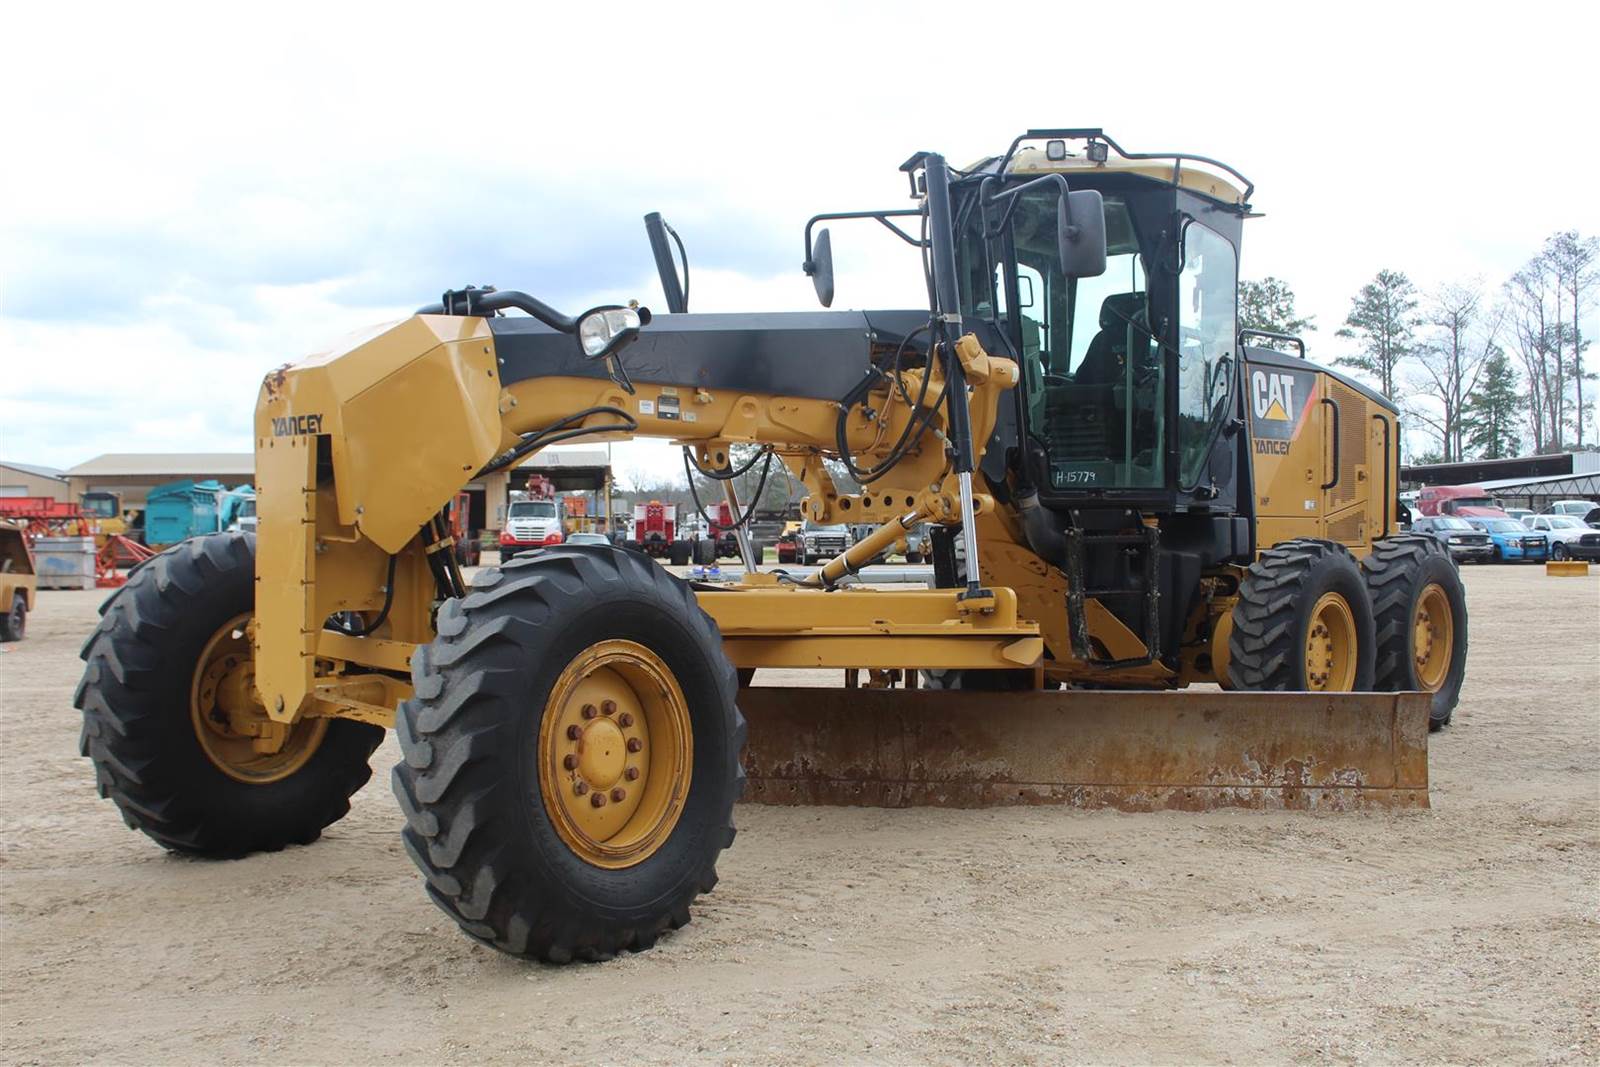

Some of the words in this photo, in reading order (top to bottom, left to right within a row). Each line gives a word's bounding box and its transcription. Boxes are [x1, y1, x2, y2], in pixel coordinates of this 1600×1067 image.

[1252, 370, 1294, 421] CAT
[271, 413, 324, 437] YANCEY
[1254, 439, 1291, 456] YANCEY
